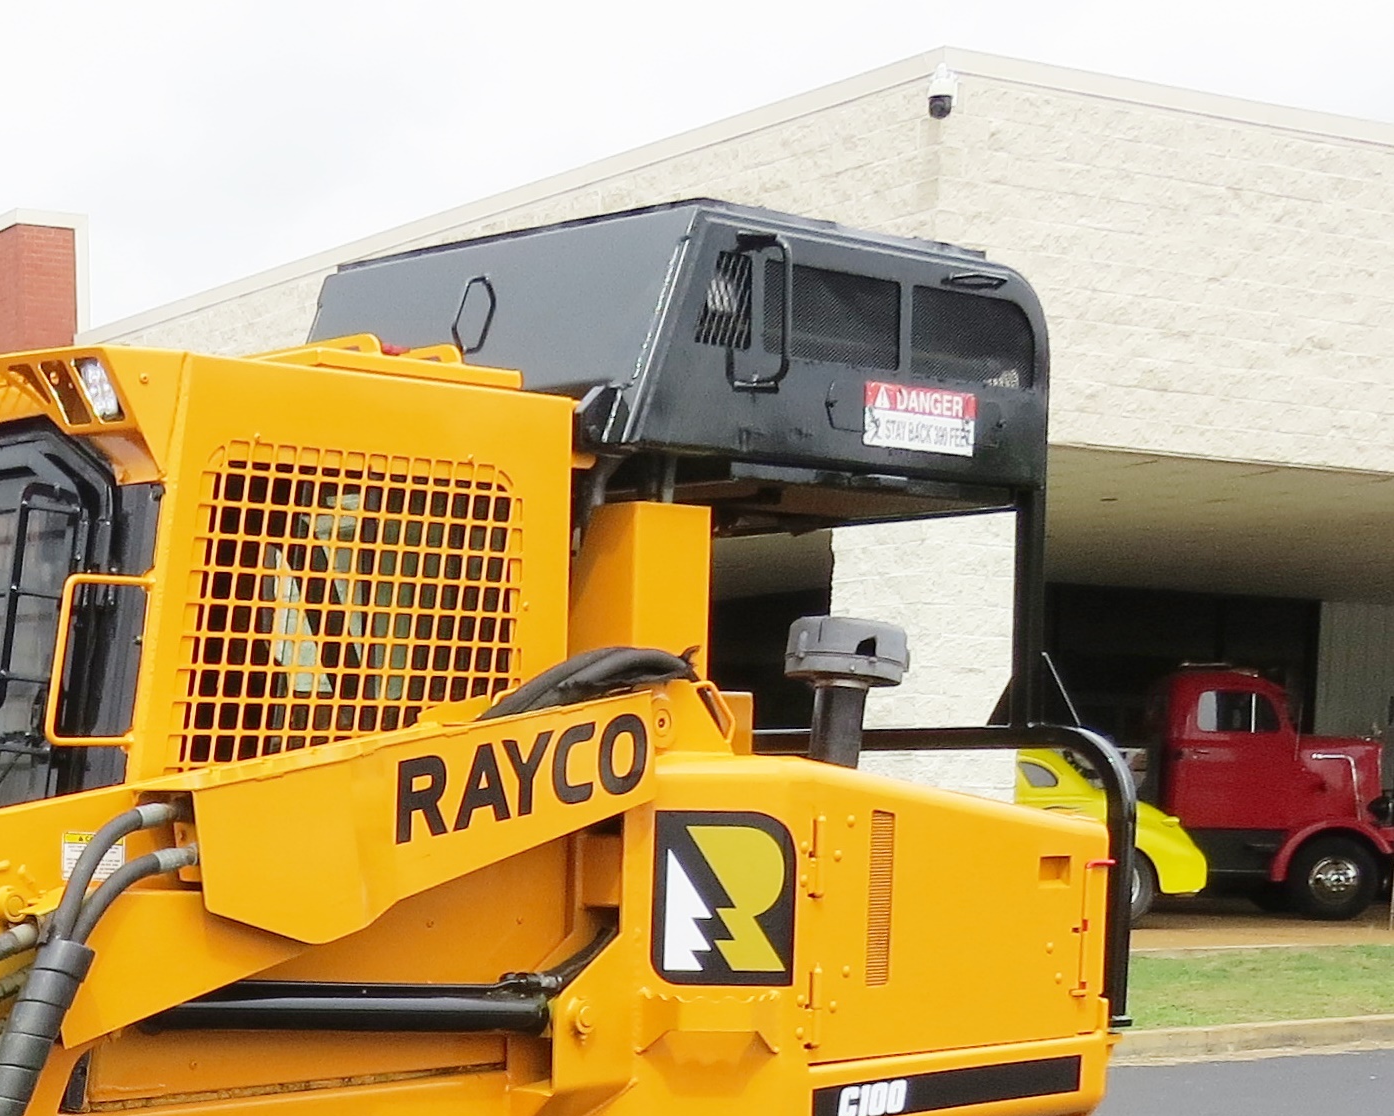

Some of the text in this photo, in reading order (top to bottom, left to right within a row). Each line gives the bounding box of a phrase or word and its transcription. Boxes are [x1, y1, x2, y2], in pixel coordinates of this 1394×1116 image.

[896, 386, 964, 418] DANGER
[885, 419, 906, 441] STAY
[908, 421, 933, 444] BACK
[394, 712, 649, 845] RAYCO
